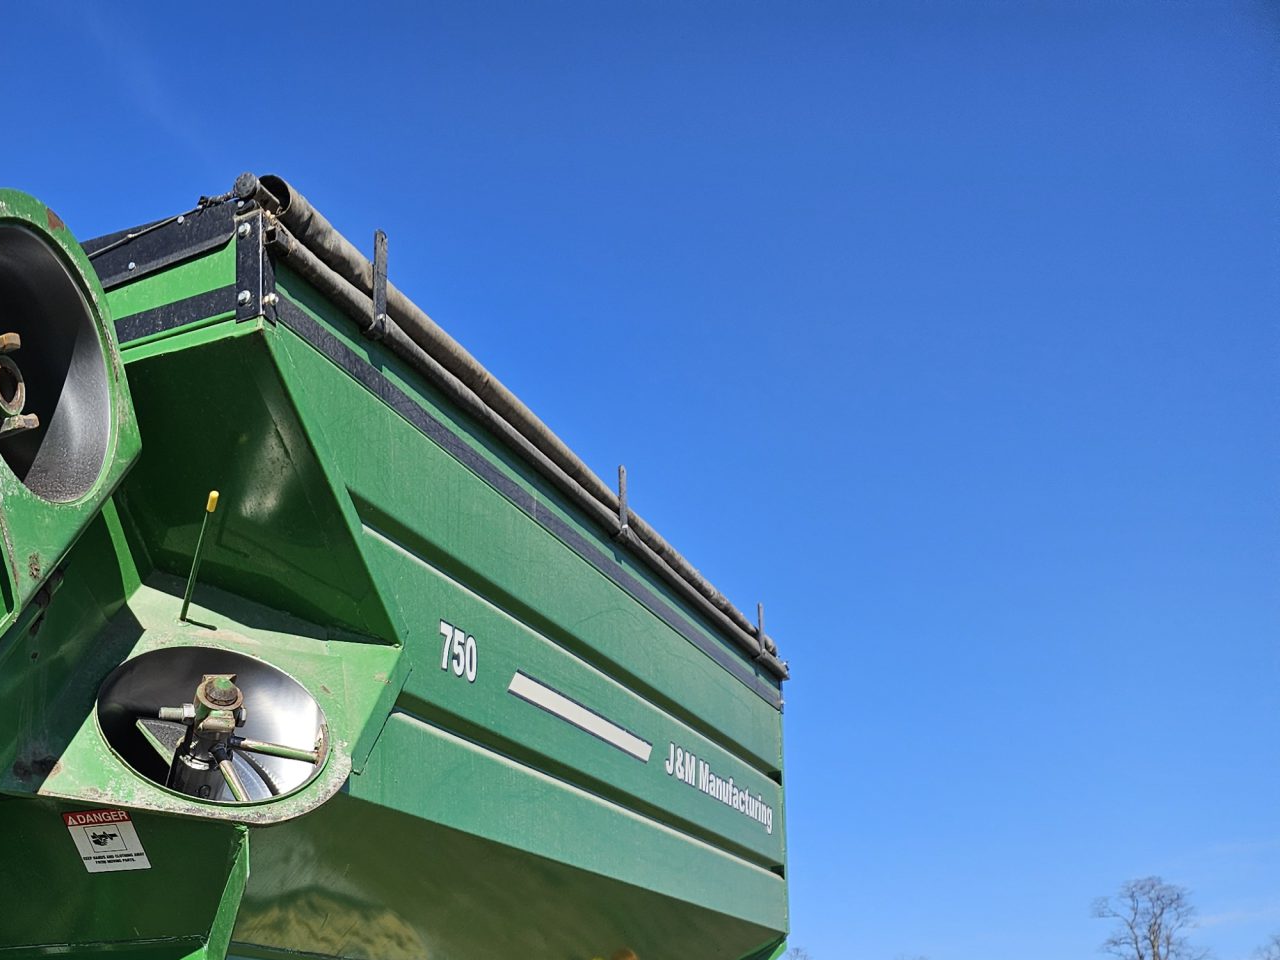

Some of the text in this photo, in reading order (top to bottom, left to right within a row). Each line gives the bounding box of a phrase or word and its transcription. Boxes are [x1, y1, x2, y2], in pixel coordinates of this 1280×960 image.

[440, 619, 478, 683] 750
[77, 810, 128, 824] DANGER
[665, 741, 773, 835] J&M Manufacturing
